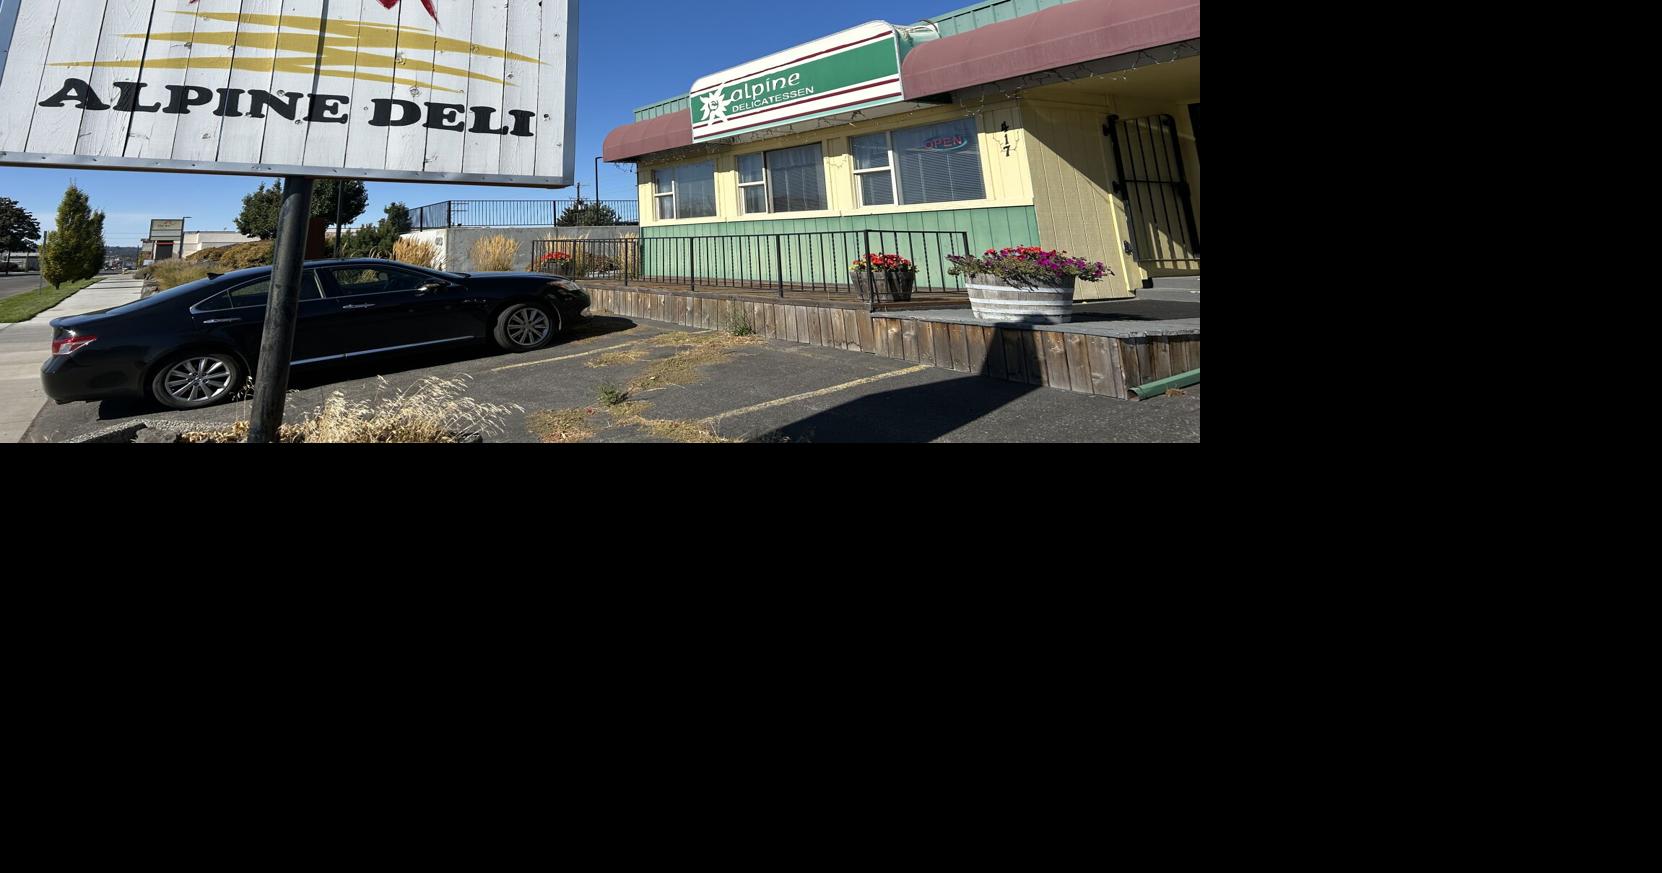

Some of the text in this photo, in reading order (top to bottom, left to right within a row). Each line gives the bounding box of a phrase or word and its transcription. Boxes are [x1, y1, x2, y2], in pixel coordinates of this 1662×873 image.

[730, 72, 800, 102] alpine
[731, 86, 814, 113] DELICATESSEN
[38, 78, 535, 136] ALPINE DELI
[925, 136, 962, 150] OPEN
